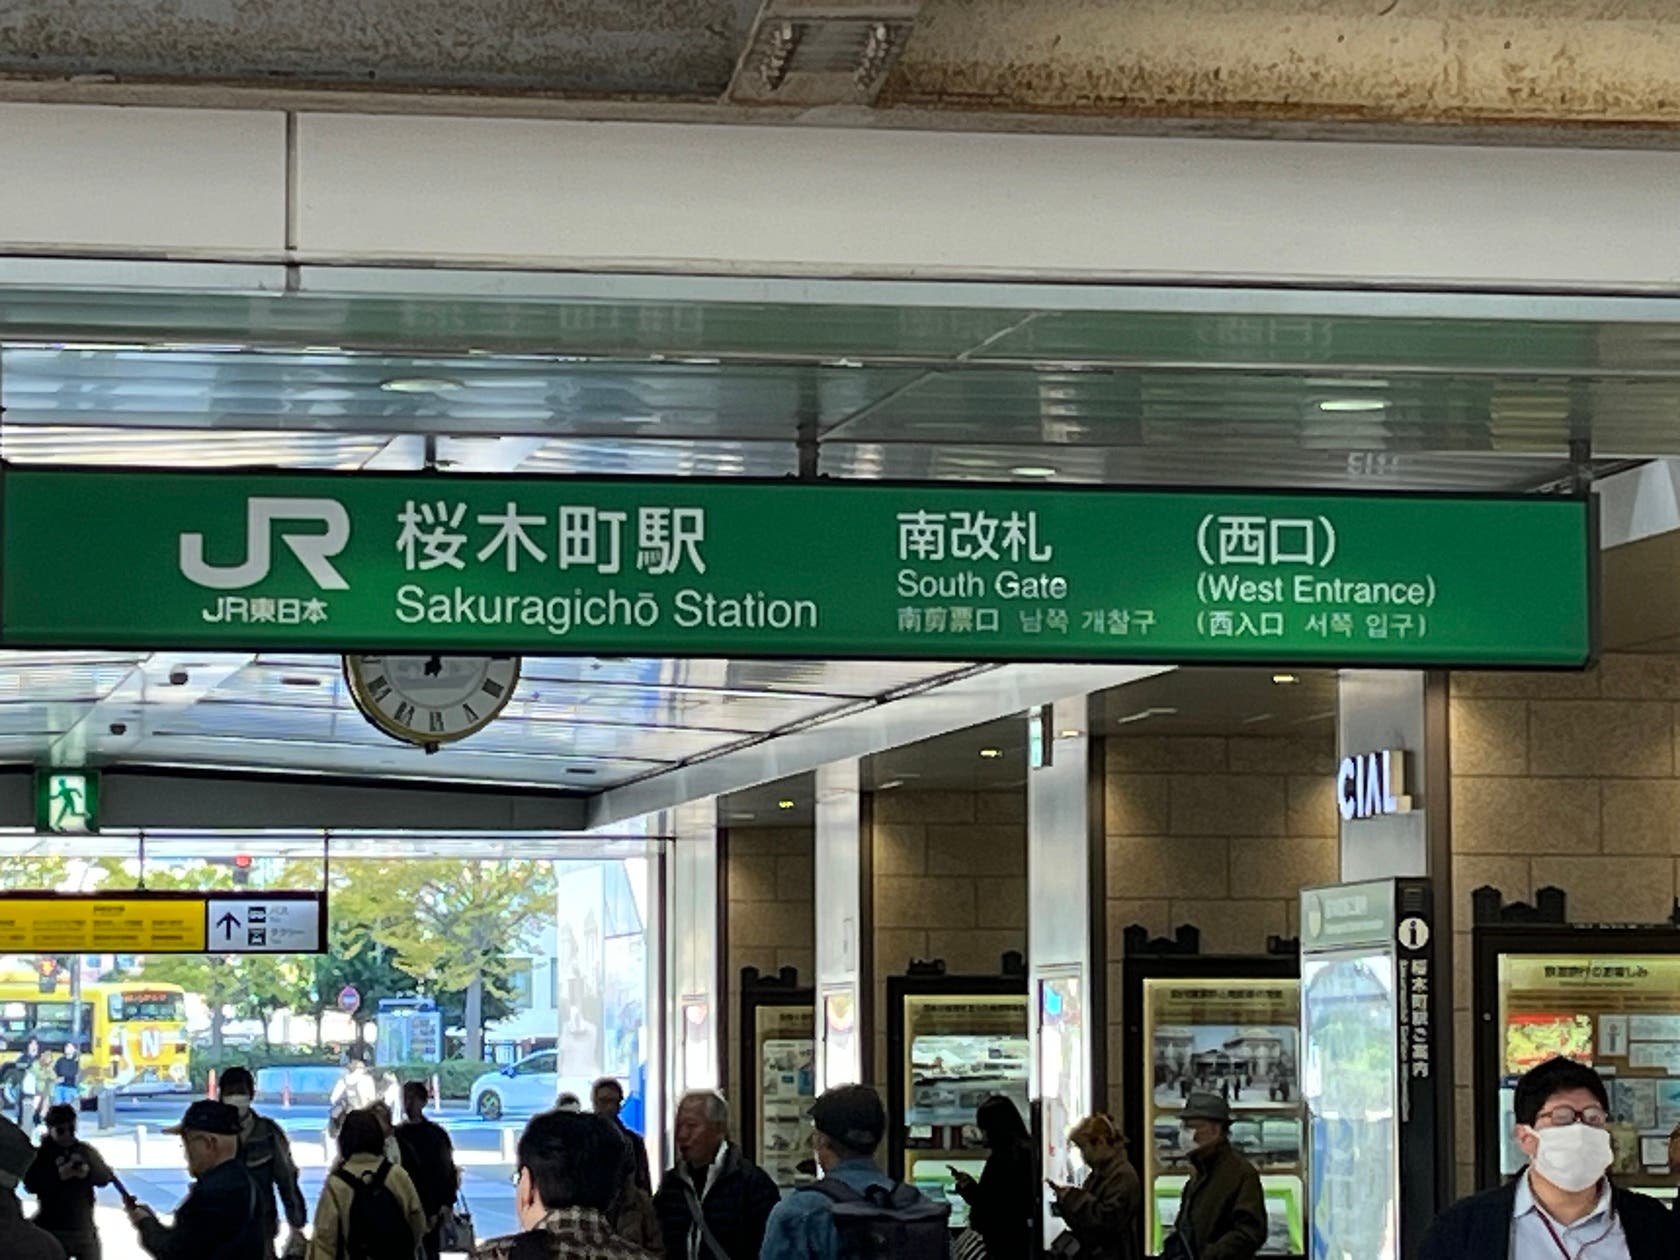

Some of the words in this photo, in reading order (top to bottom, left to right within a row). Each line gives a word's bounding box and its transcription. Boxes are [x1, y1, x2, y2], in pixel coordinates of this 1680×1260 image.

[179, 497, 351, 591] JR
[396, 499, 707, 577] 桜木町駅
[896, 509, 1053, 563] 南改札
[1196, 513, 1338, 568] (西口)
[202, 596, 328, 624] JR東日本
[395, 584, 660, 636] Sakuragichō
[674, 589, 818, 629] Station
[897, 568, 986, 598] South
[994, 570, 1068, 599] Gate
[1196, 571, 1284, 604] (West
[1294, 574, 1436, 607] Entrance)
[897, 606, 999, 632] 南剪票口
[1338, 749, 1400, 820] CIAL
